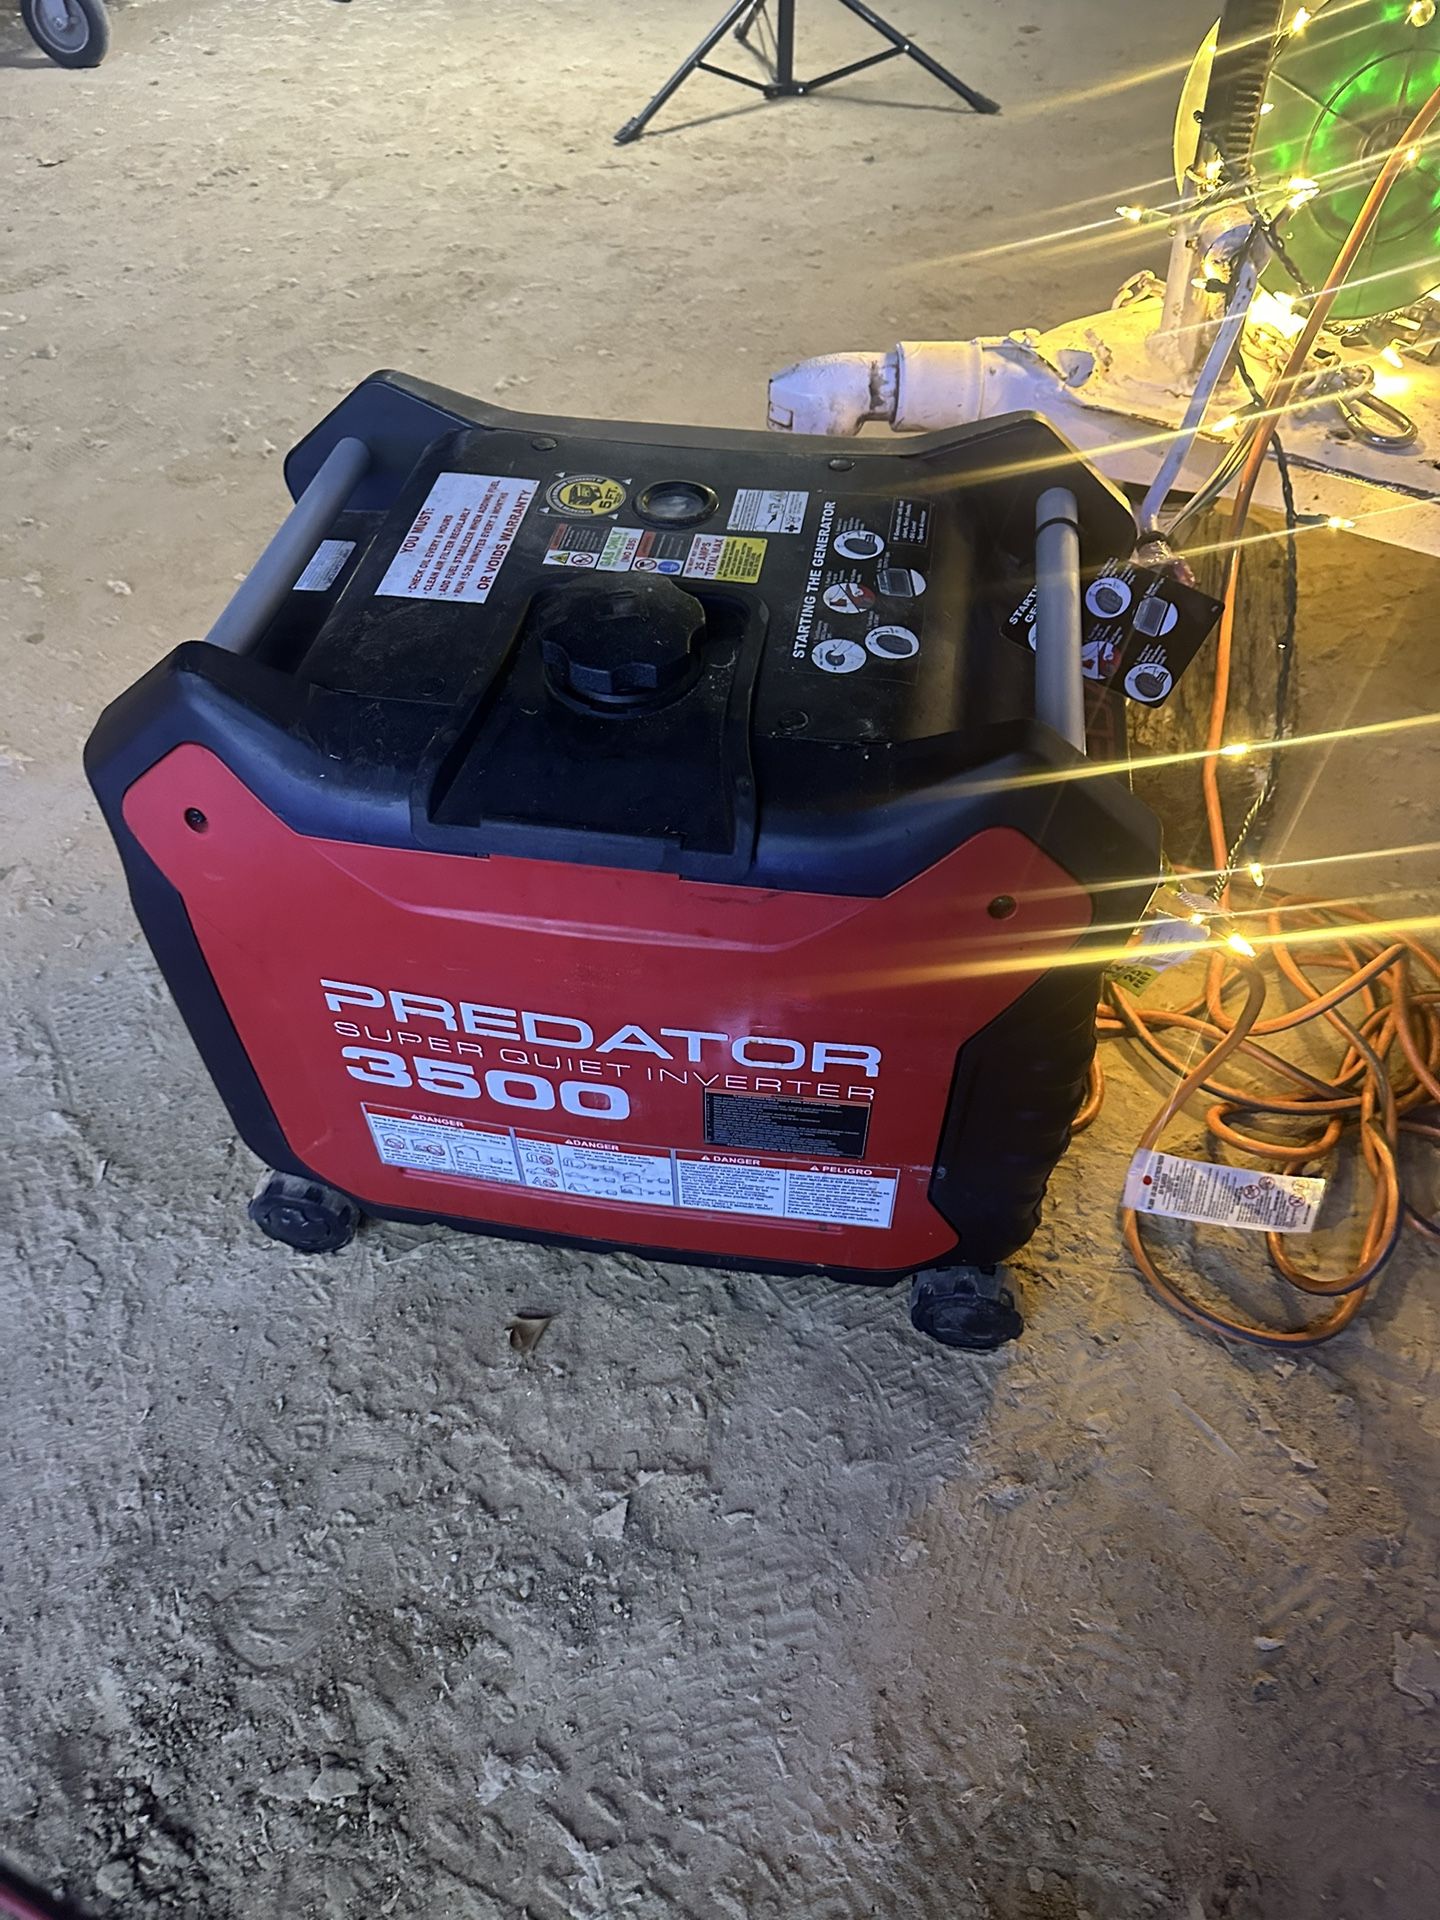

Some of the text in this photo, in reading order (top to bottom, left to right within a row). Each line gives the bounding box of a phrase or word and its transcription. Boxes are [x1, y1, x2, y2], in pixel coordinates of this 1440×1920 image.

[399, 507, 434, 553] YOU MUST:
[437, 514, 453, 533] HOURS
[438, 479, 500, 592] ADD FUEL STABILIZER WHEN ADDING FUEL
[422, 507, 470, 591] CLEAN AIR FILTER REGULARLY
[424, 539, 440, 557] EVERY
[453, 580, 466, 593] RUN
[460, 564, 474, 579] 15-20
[467, 538, 486, 563] MINUTES
[480, 519, 495, 537] EVERY
[491, 492, 508, 514] MONTHS
[476, 489, 531, 590] OR VOIDS WARRANTY
[605, 530, 623, 550] ONLY
[418, 558, 431, 568] OIL
[599, 551, 615, 567] GAS
[694, 542, 711, 570] 25 AMPS
[703, 538, 724, 576] TOTAL MAX
[407, 569, 425, 589] CHECK
[792, 501, 835, 658] STARTING THE GENERATOR
[320, 978, 882, 1079] PREDATOR
[333, 1019, 876, 1102] SUPER QUIET INVERTER
[341, 1045, 631, 1121] 3500
[418, 1114, 464, 1128] DANGER
[572, 1139, 619, 1151] DANGER
[712, 1155, 761, 1167] DANGER
[821, 1164, 873, 1176] PELIGRO
